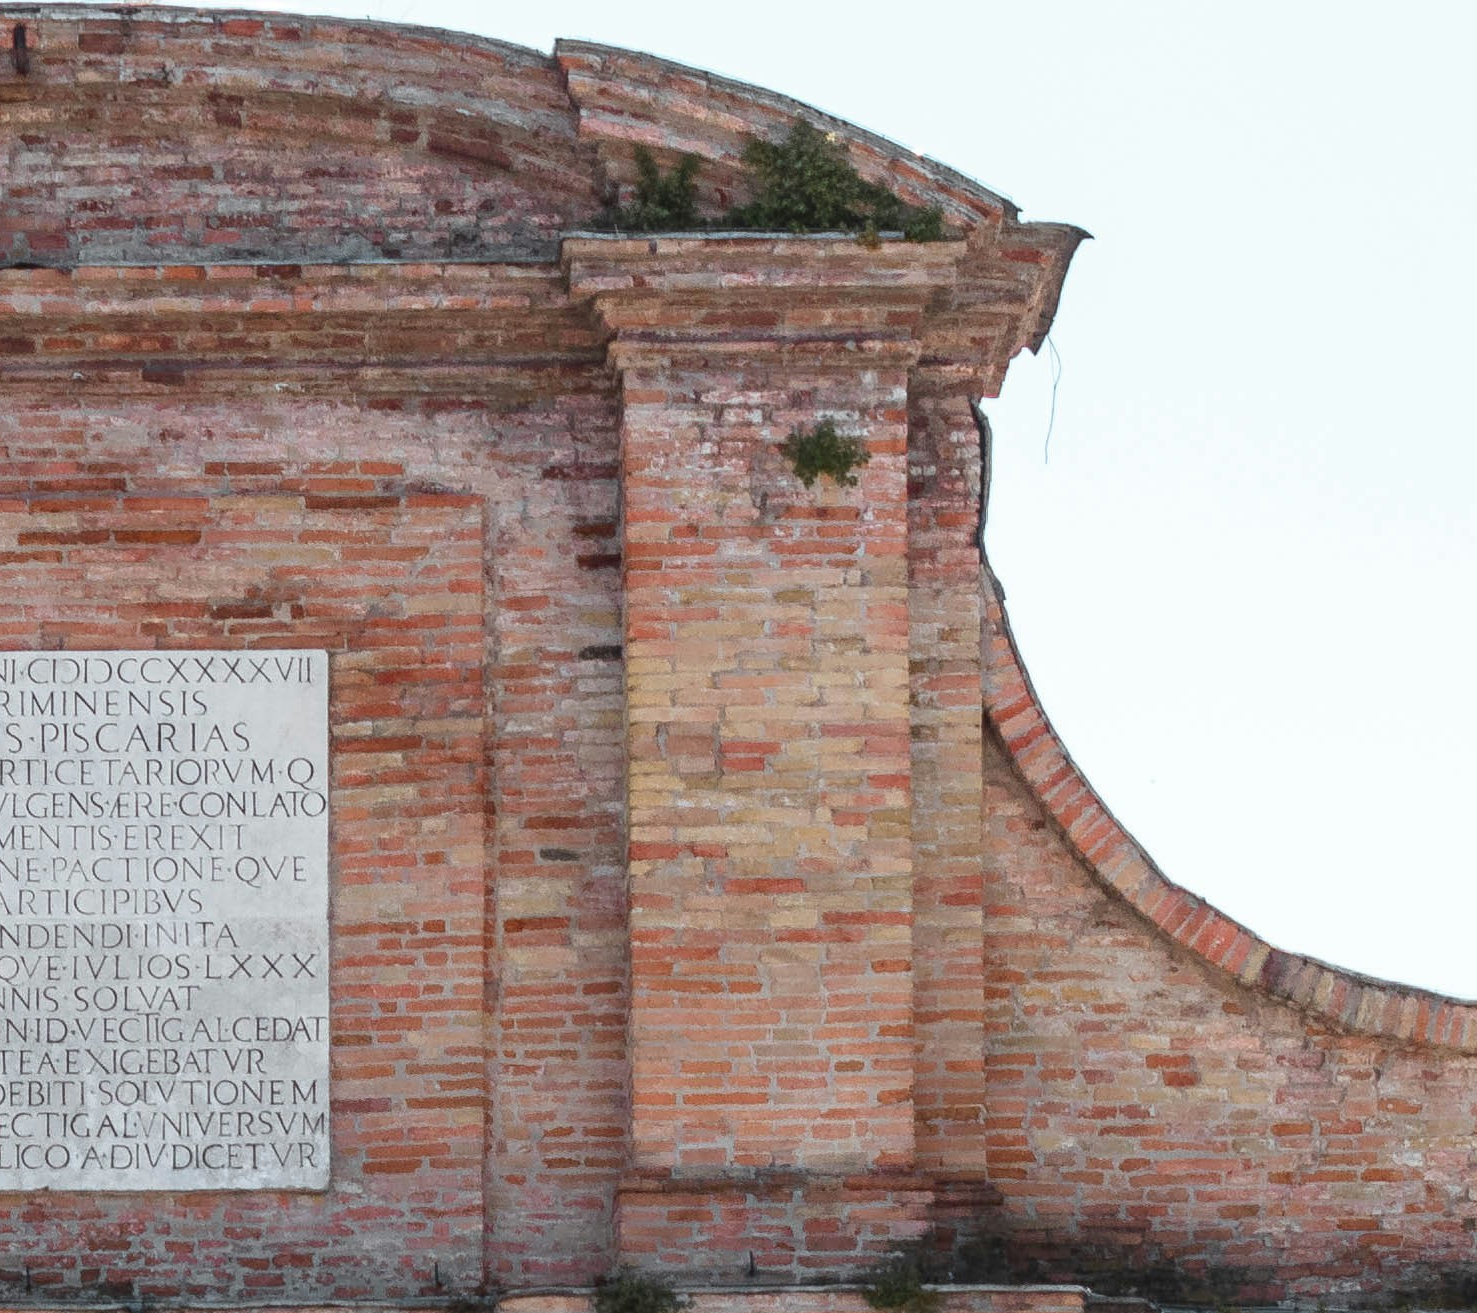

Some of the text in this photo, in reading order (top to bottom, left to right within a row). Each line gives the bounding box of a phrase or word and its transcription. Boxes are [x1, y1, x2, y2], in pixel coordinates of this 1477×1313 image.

[41, 721, 251, 754] PISCARIAS
[178, 790, 327, 818] CONLATO
[124, 824, 246, 851] EREXIT
[72, 953, 191, 982] IVLIOS
[204, 952, 317, 980] LXXX
[73, 984, 202, 1013] SOLVAT
[35, 1017, 69, 1044] ID
[75, 1012, 225, 1044] VECTIGAL
[231, 1016, 327, 1043] CEDAT
[65, 1048, 268, 1075] EXIGEBATVR
[98, 1079, 318, 1106] SOLVTIONEM
[136, 1111, 326, 1140] VNIVERSVM
